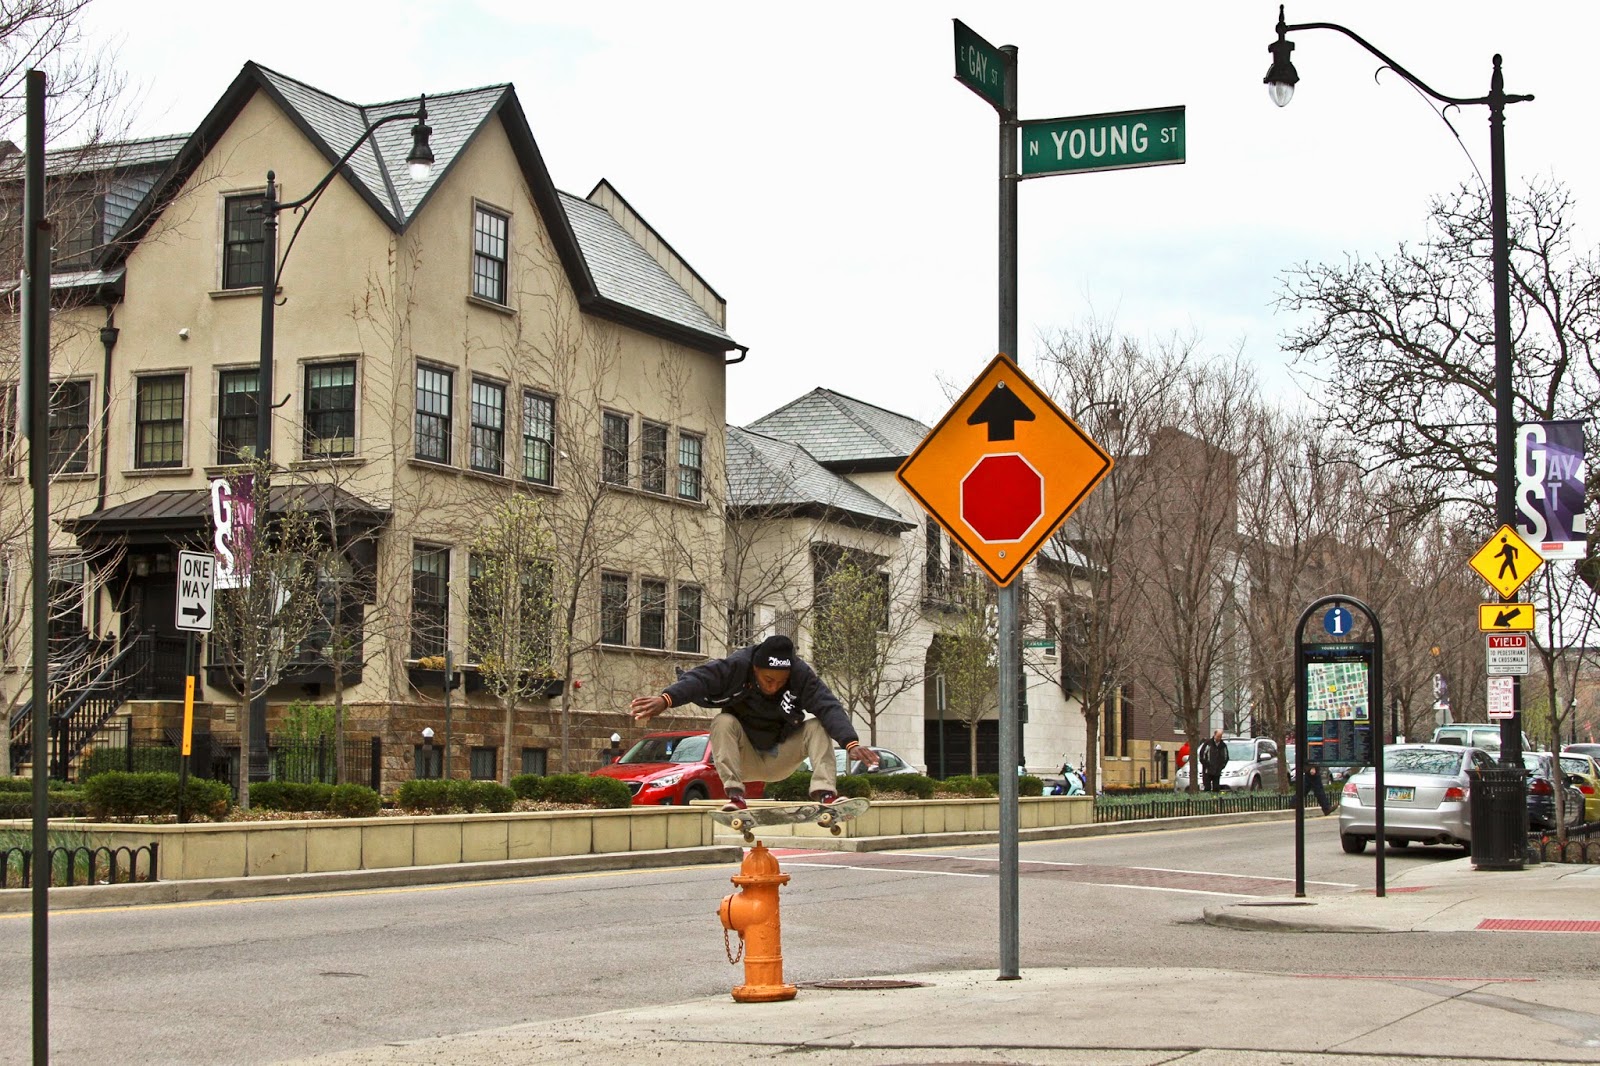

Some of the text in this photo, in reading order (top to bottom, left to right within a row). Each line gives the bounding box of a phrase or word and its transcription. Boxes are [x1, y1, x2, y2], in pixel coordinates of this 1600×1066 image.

[960, 45, 998, 86] E GAY ST
[1030, 122, 1178, 160] N YOUNG ST
[184, 559, 210, 579] ONE
[182, 580, 210, 599] WAY
[1493, 637, 1523, 647] YIELD
